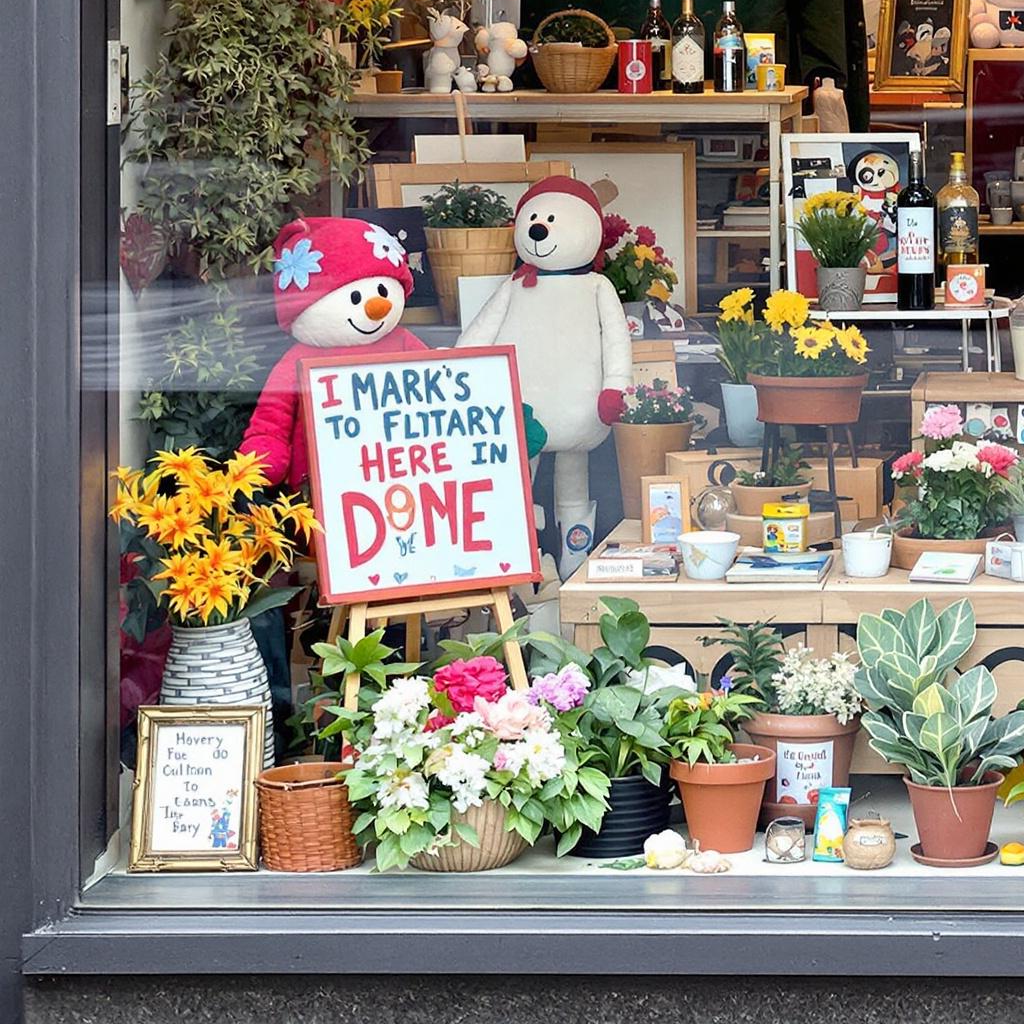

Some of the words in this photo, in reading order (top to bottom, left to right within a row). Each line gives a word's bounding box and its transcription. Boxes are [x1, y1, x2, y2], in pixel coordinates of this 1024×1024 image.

[318, 374, 343, 409] I
[324, 414, 361, 440] TO
[359, 441, 453, 483] HERE
[471, 441, 508, 466] IN
